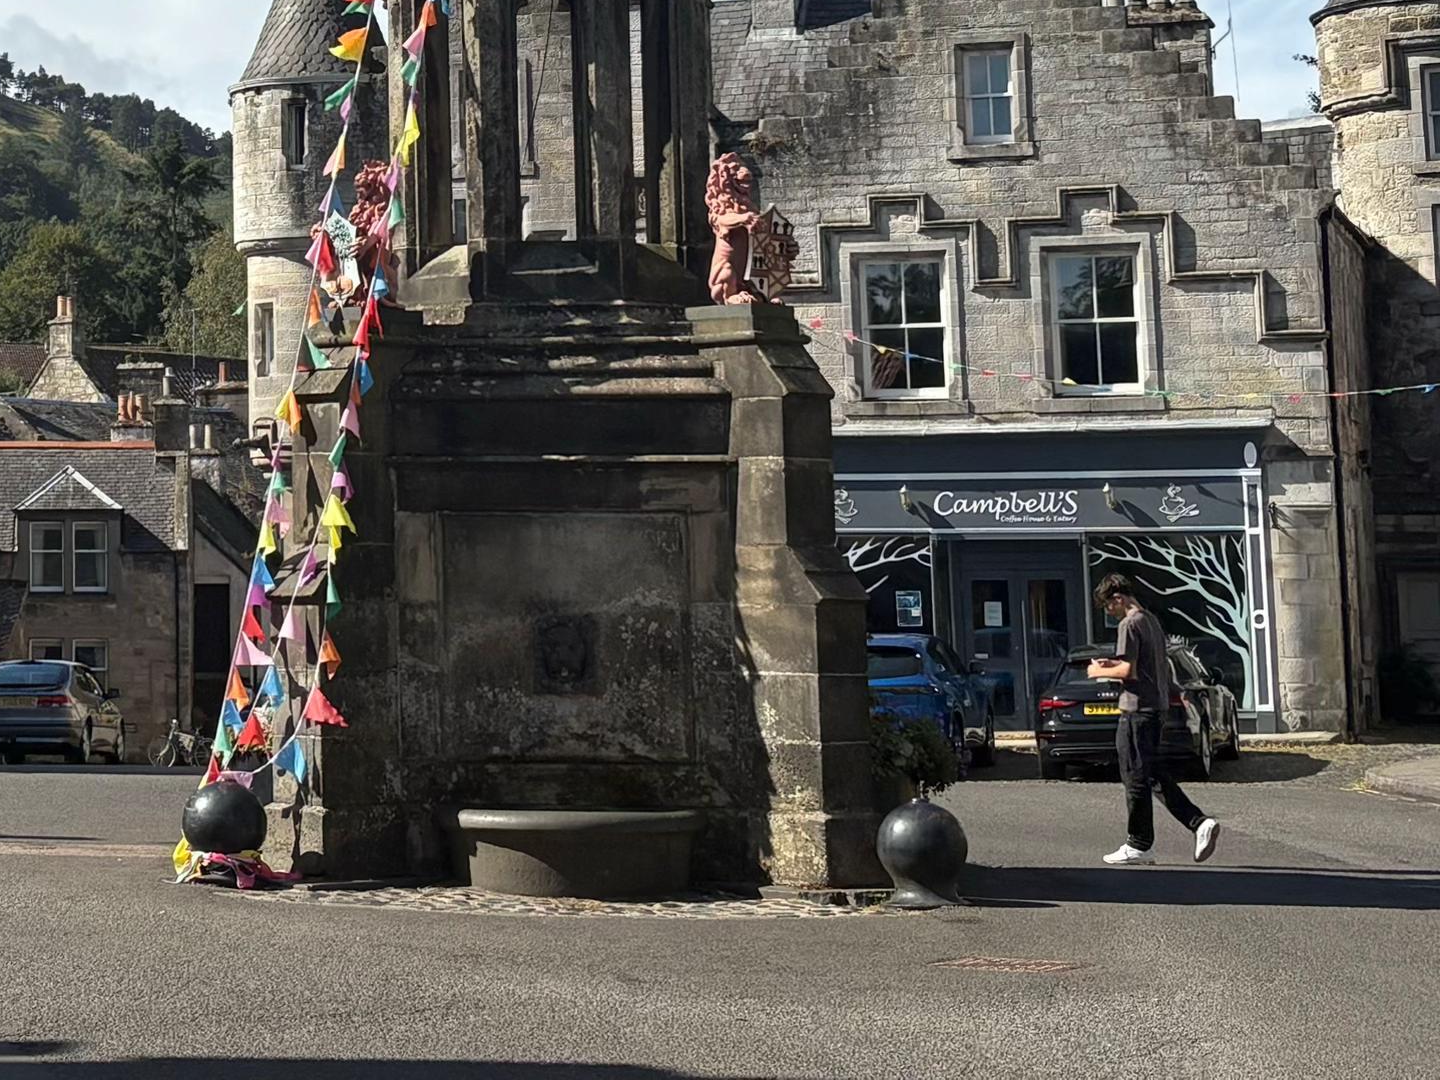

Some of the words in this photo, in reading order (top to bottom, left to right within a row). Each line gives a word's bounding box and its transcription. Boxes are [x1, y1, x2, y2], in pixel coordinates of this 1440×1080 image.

[1000, 514, 1022, 523] Coffee
[1023, 515, 1045, 523] House
[1054, 515, 1078, 525] Eatery
